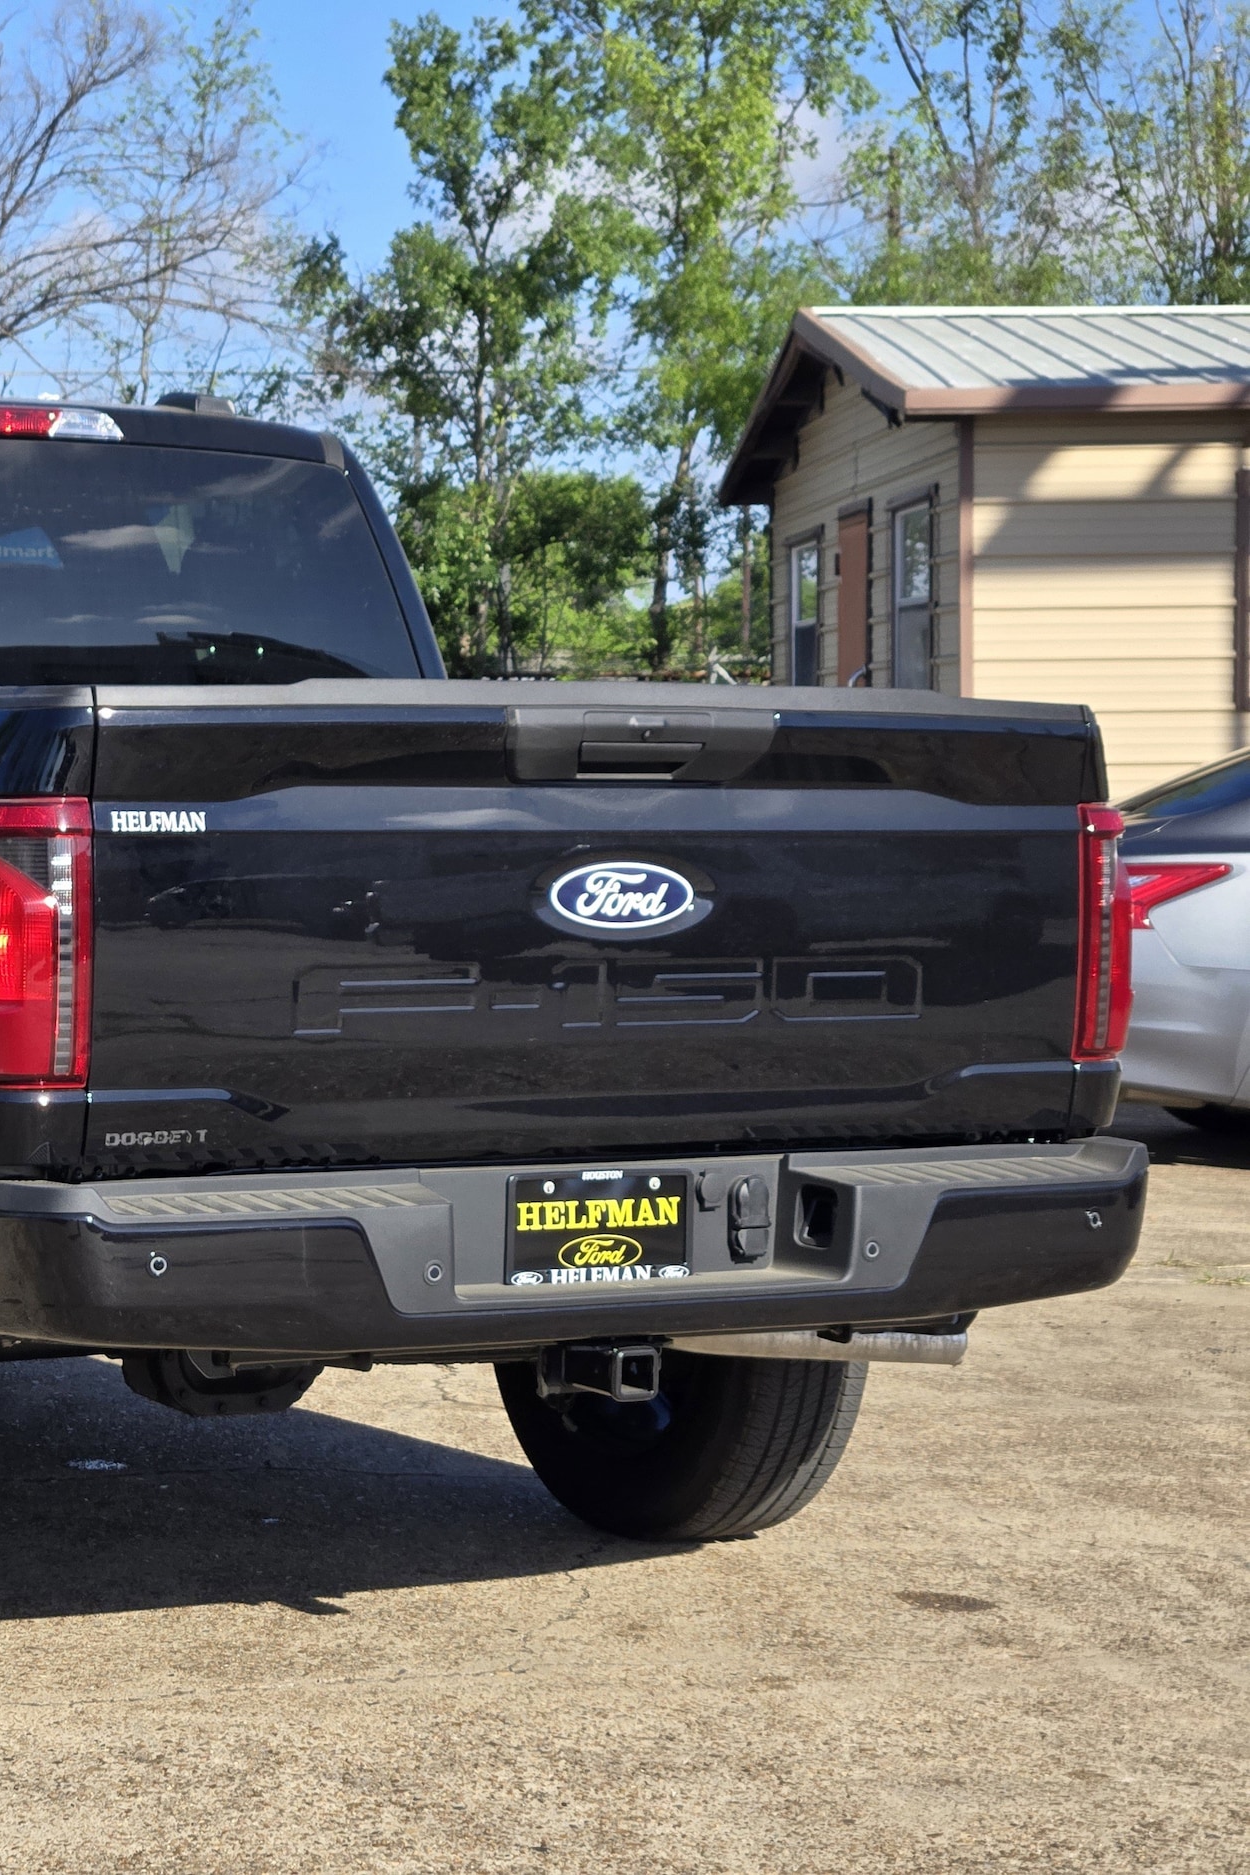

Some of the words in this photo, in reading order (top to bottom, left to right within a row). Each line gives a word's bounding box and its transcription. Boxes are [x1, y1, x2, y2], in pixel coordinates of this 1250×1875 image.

[110, 811, 207, 832] HELFMAN
[576, 871, 669, 917] Ford
[581, 1170, 623, 1181] HOUSTON
[516, 1196, 681, 1231] HELFMAN
[574, 1239, 626, 1266] Ford
